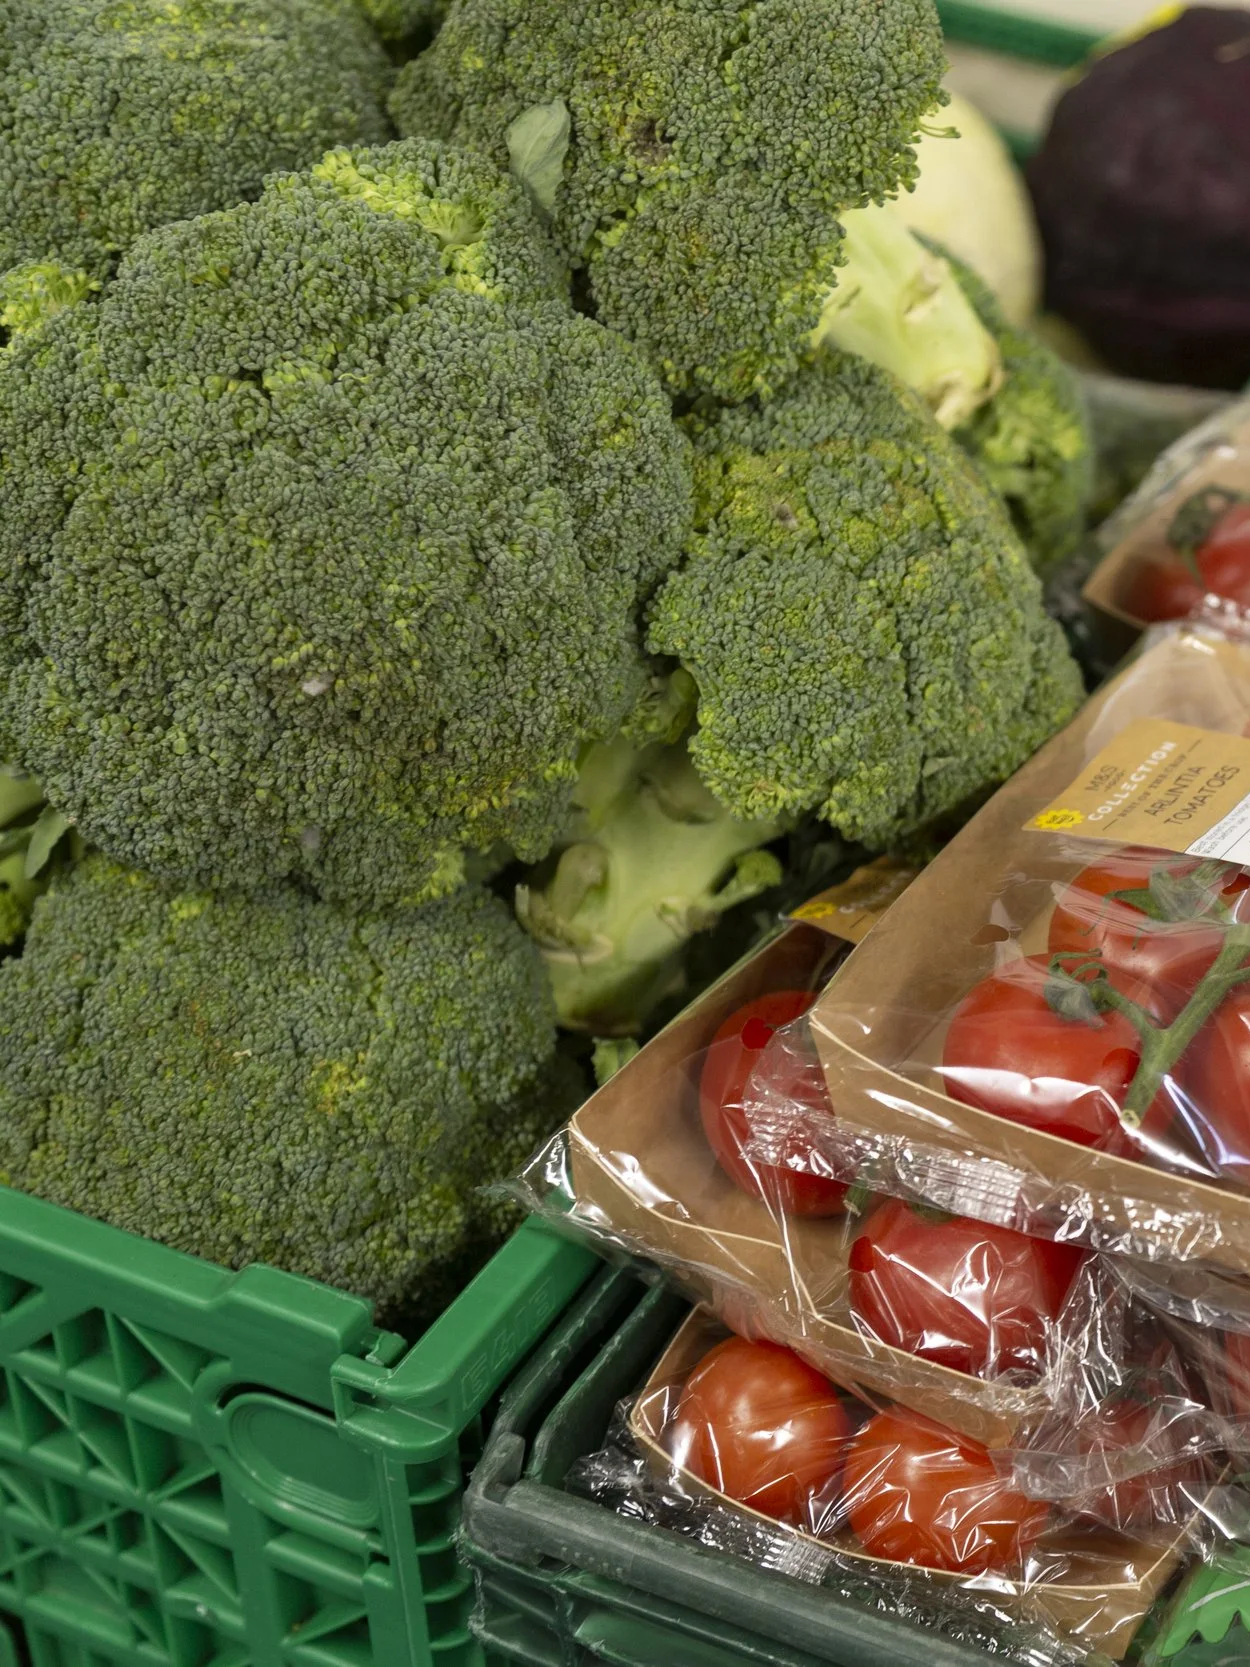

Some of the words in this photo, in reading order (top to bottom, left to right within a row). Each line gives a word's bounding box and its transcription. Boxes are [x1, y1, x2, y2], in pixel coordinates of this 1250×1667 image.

[1085, 765, 1118, 792] M&S
[1088, 741, 1177, 821] COLLECTION
[1144, 766, 1206, 816] ARLINTIA
[1163, 765, 1240, 825] TOMATOES
